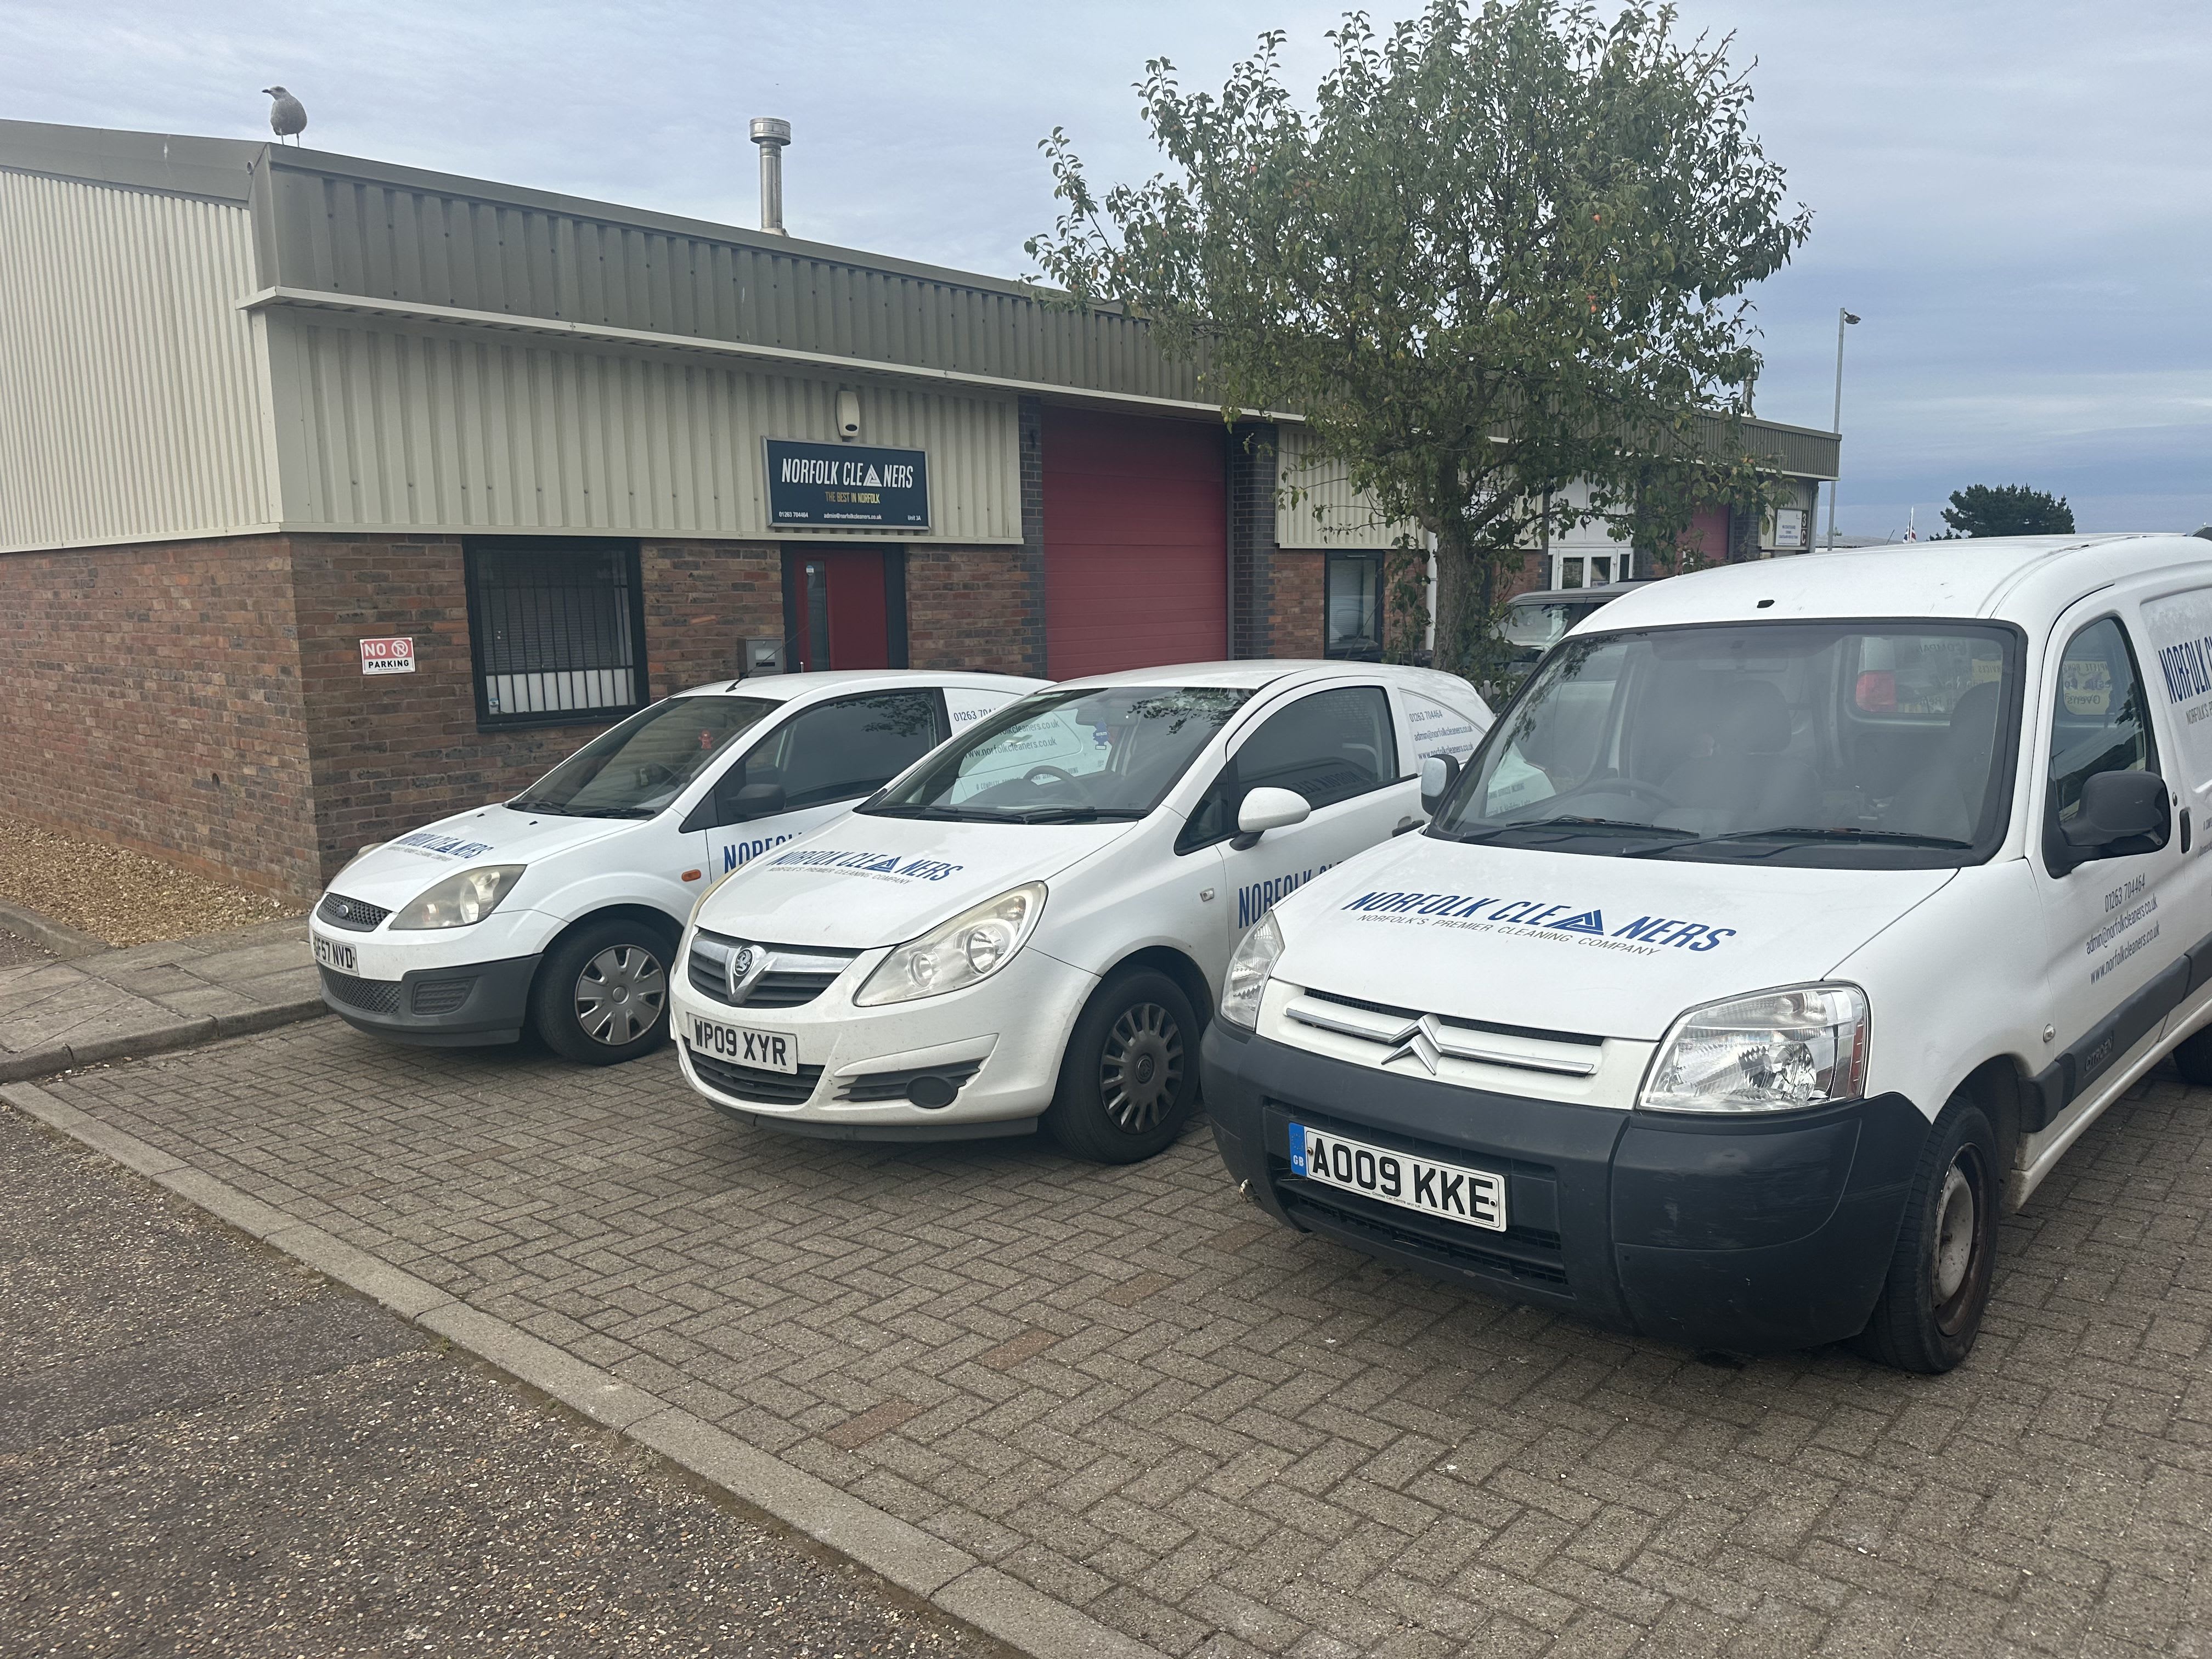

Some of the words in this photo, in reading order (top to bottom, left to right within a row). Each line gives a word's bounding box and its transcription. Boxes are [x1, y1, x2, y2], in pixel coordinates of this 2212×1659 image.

[781, 458, 839, 485] NORFOLK
[825, 492, 836, 502] THE
[837, 492, 850, 503] BEST
[851, 493, 856, 503] IN
[858, 493, 880, 504] NORFOLK
[1802, 514, 1807, 527] 3
[1801, 531, 1806, 544] C
[364, 643, 386, 656] NO
[369, 660, 409, 668] PARKING
[2158, 639, 2211, 704] NORFOLK
[953, 710, 977, 721] 01263
[1409, 712, 1425, 722] 01263
[766, 851, 848, 866] NORFOLK
[834, 868, 872, 878] CLEANING
[872, 874, 913, 884] COMPANY
[2105, 887, 2122, 913] 01263
[2124, 872, 2145, 901] 704464
[1340, 892, 1502, 918] NORFOLK
[2086, 893, 2158, 955] admin@norfolkcleaners.co.uk
[1357, 915, 1429, 925] NORFOLK'S
[1432, 919, 1494, 932] PREMIER
[1498, 927, 1573, 942] CLEANING
[1578, 938, 1662, 955] COMPANY
[332, 944, 353, 968] NVD
[2090, 920, 2159, 985] www.norfolkcleaners.co.uk
[695, 1019, 737, 1057] WP09
[743, 1031, 786, 1065] XYR
[1293, 1154, 1304, 1167] GB
[1414, 1164, 1494, 1222] KKE
